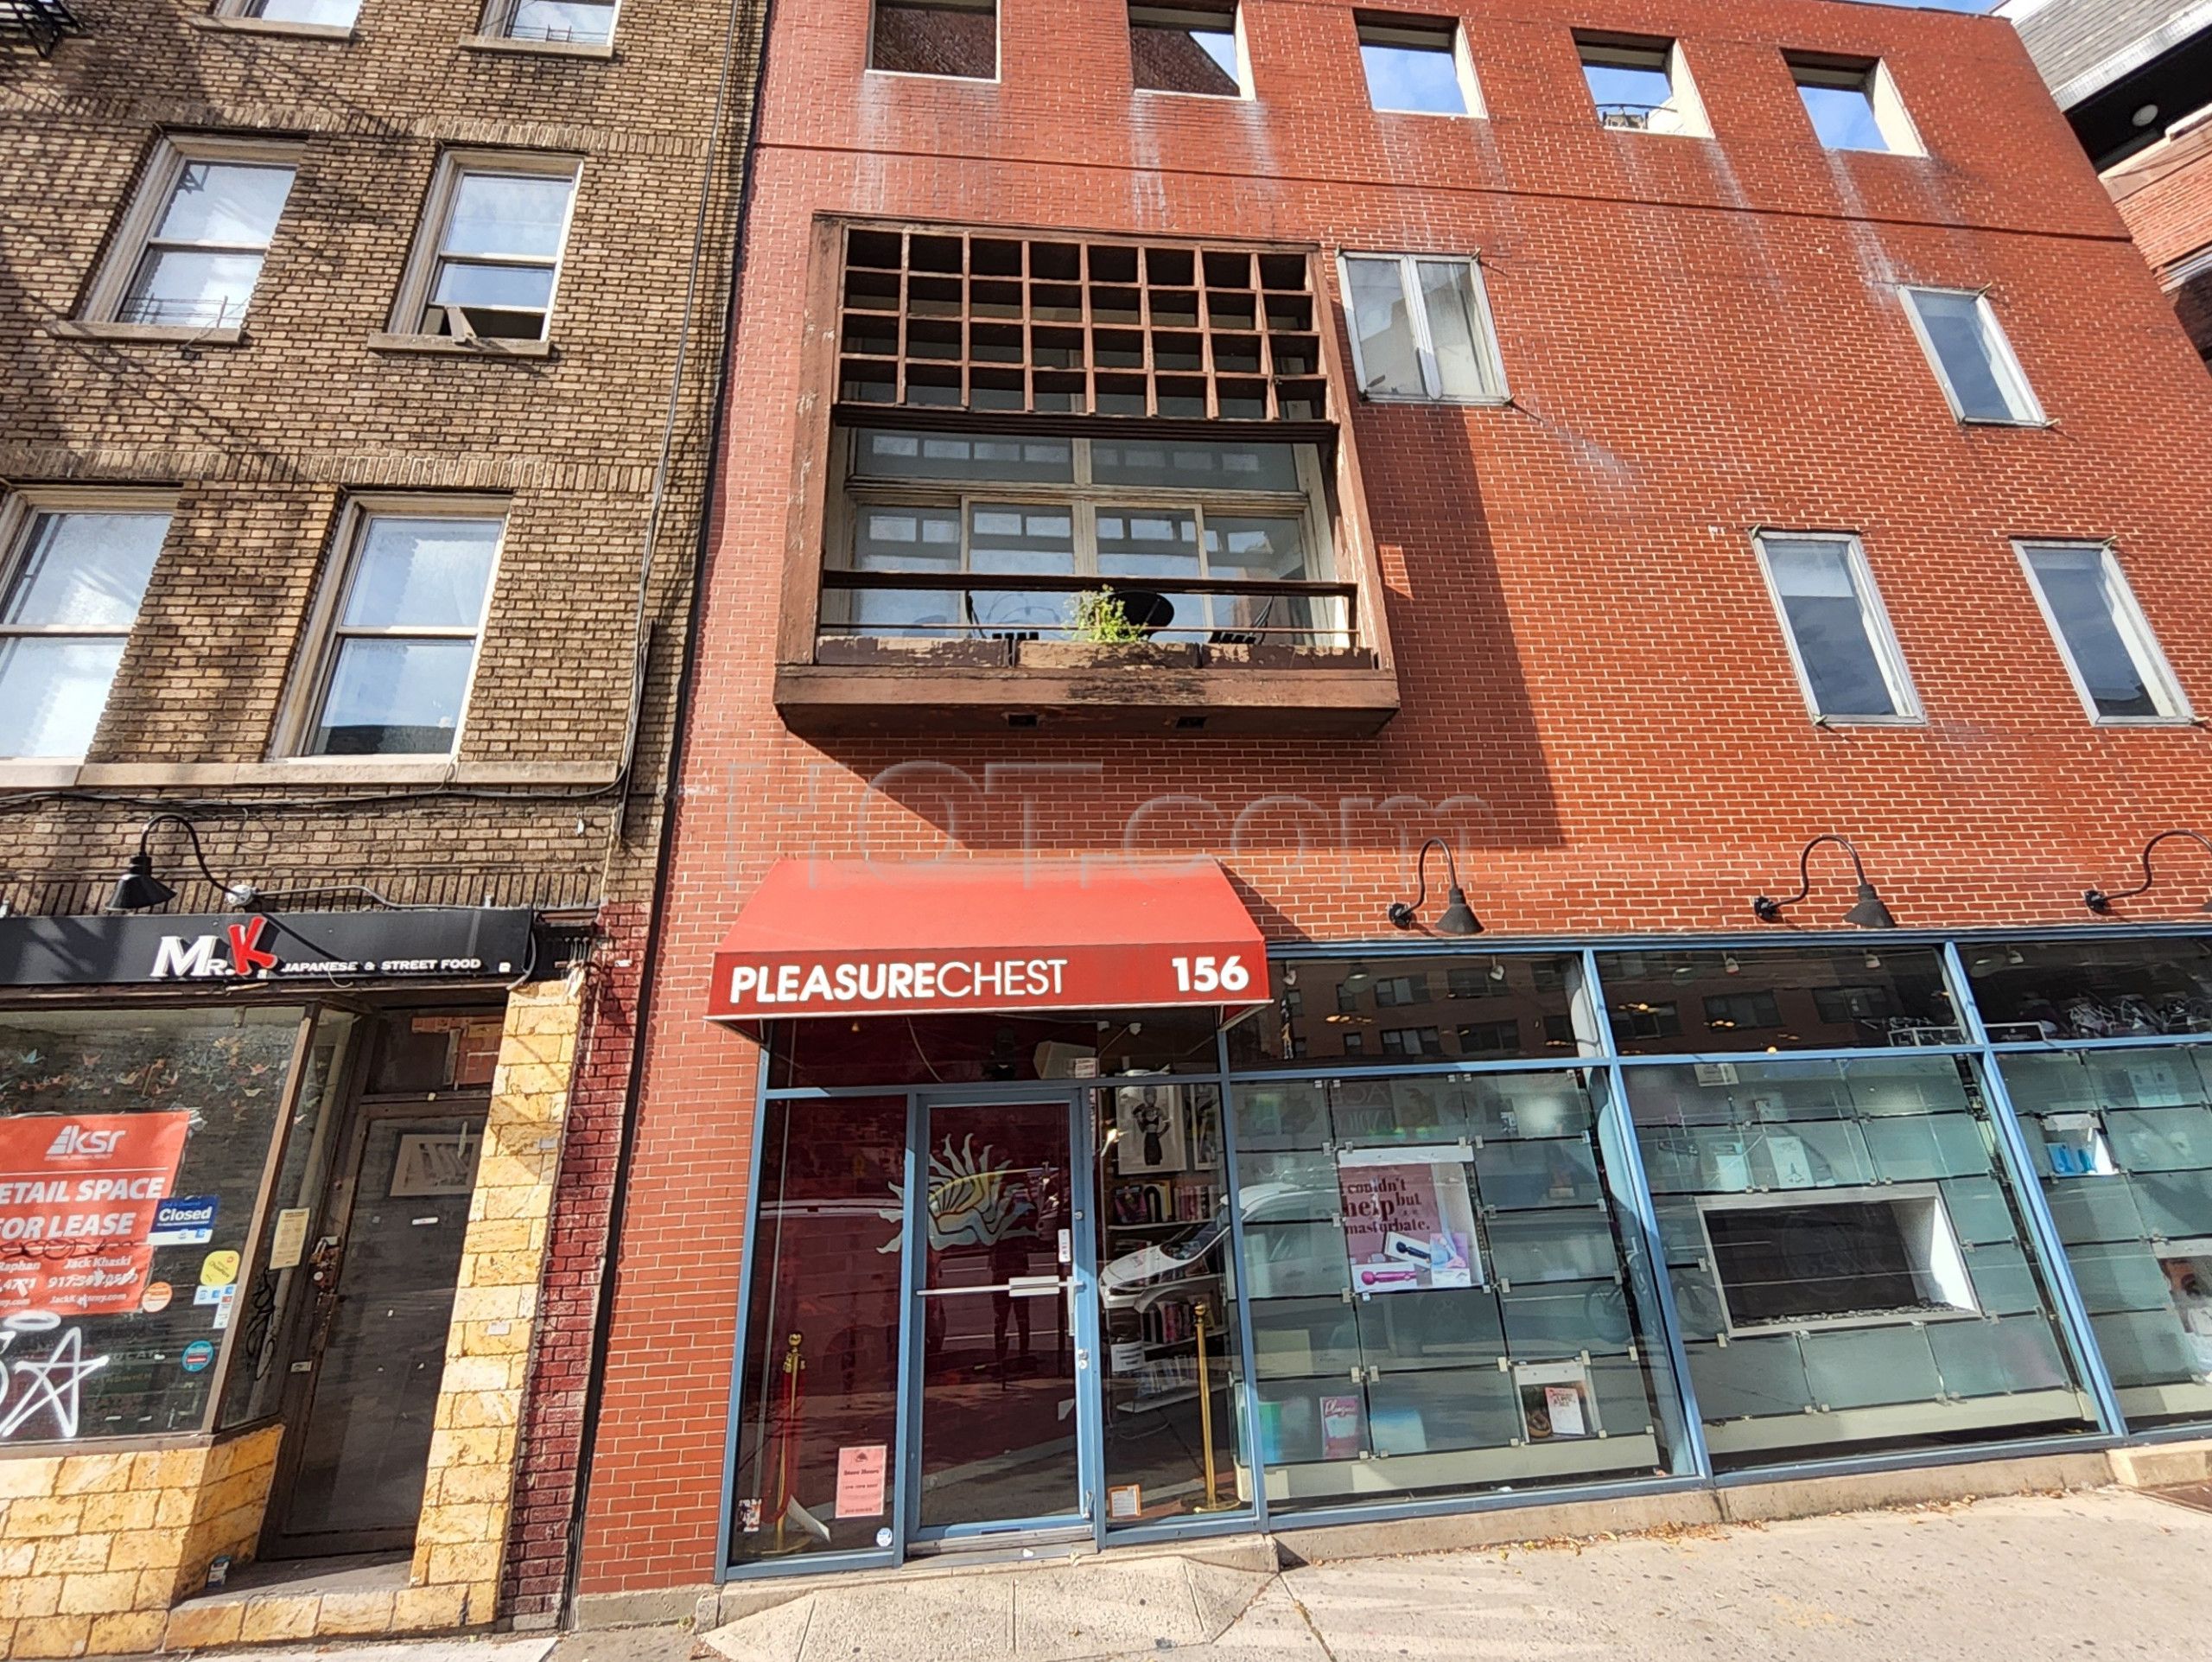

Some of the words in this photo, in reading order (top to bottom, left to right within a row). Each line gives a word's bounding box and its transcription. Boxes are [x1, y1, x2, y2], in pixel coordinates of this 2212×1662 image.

[227, 916, 277, 976] K
[282, 961, 358, 973] JAPANESE
[364, 962, 376, 972] &
[381, 958, 437, 971] STREET
[441, 958, 481, 970] FOOD
[1171, 955, 1249, 992] 156
[75, 1176, 166, 1202] SPACE
[1395, 1191, 1422, 1207] but
[158, 1206, 213, 1222] Closed
[47, 1212, 137, 1239] LEASE
[1344, 1218, 1431, 1235] masturbate.
